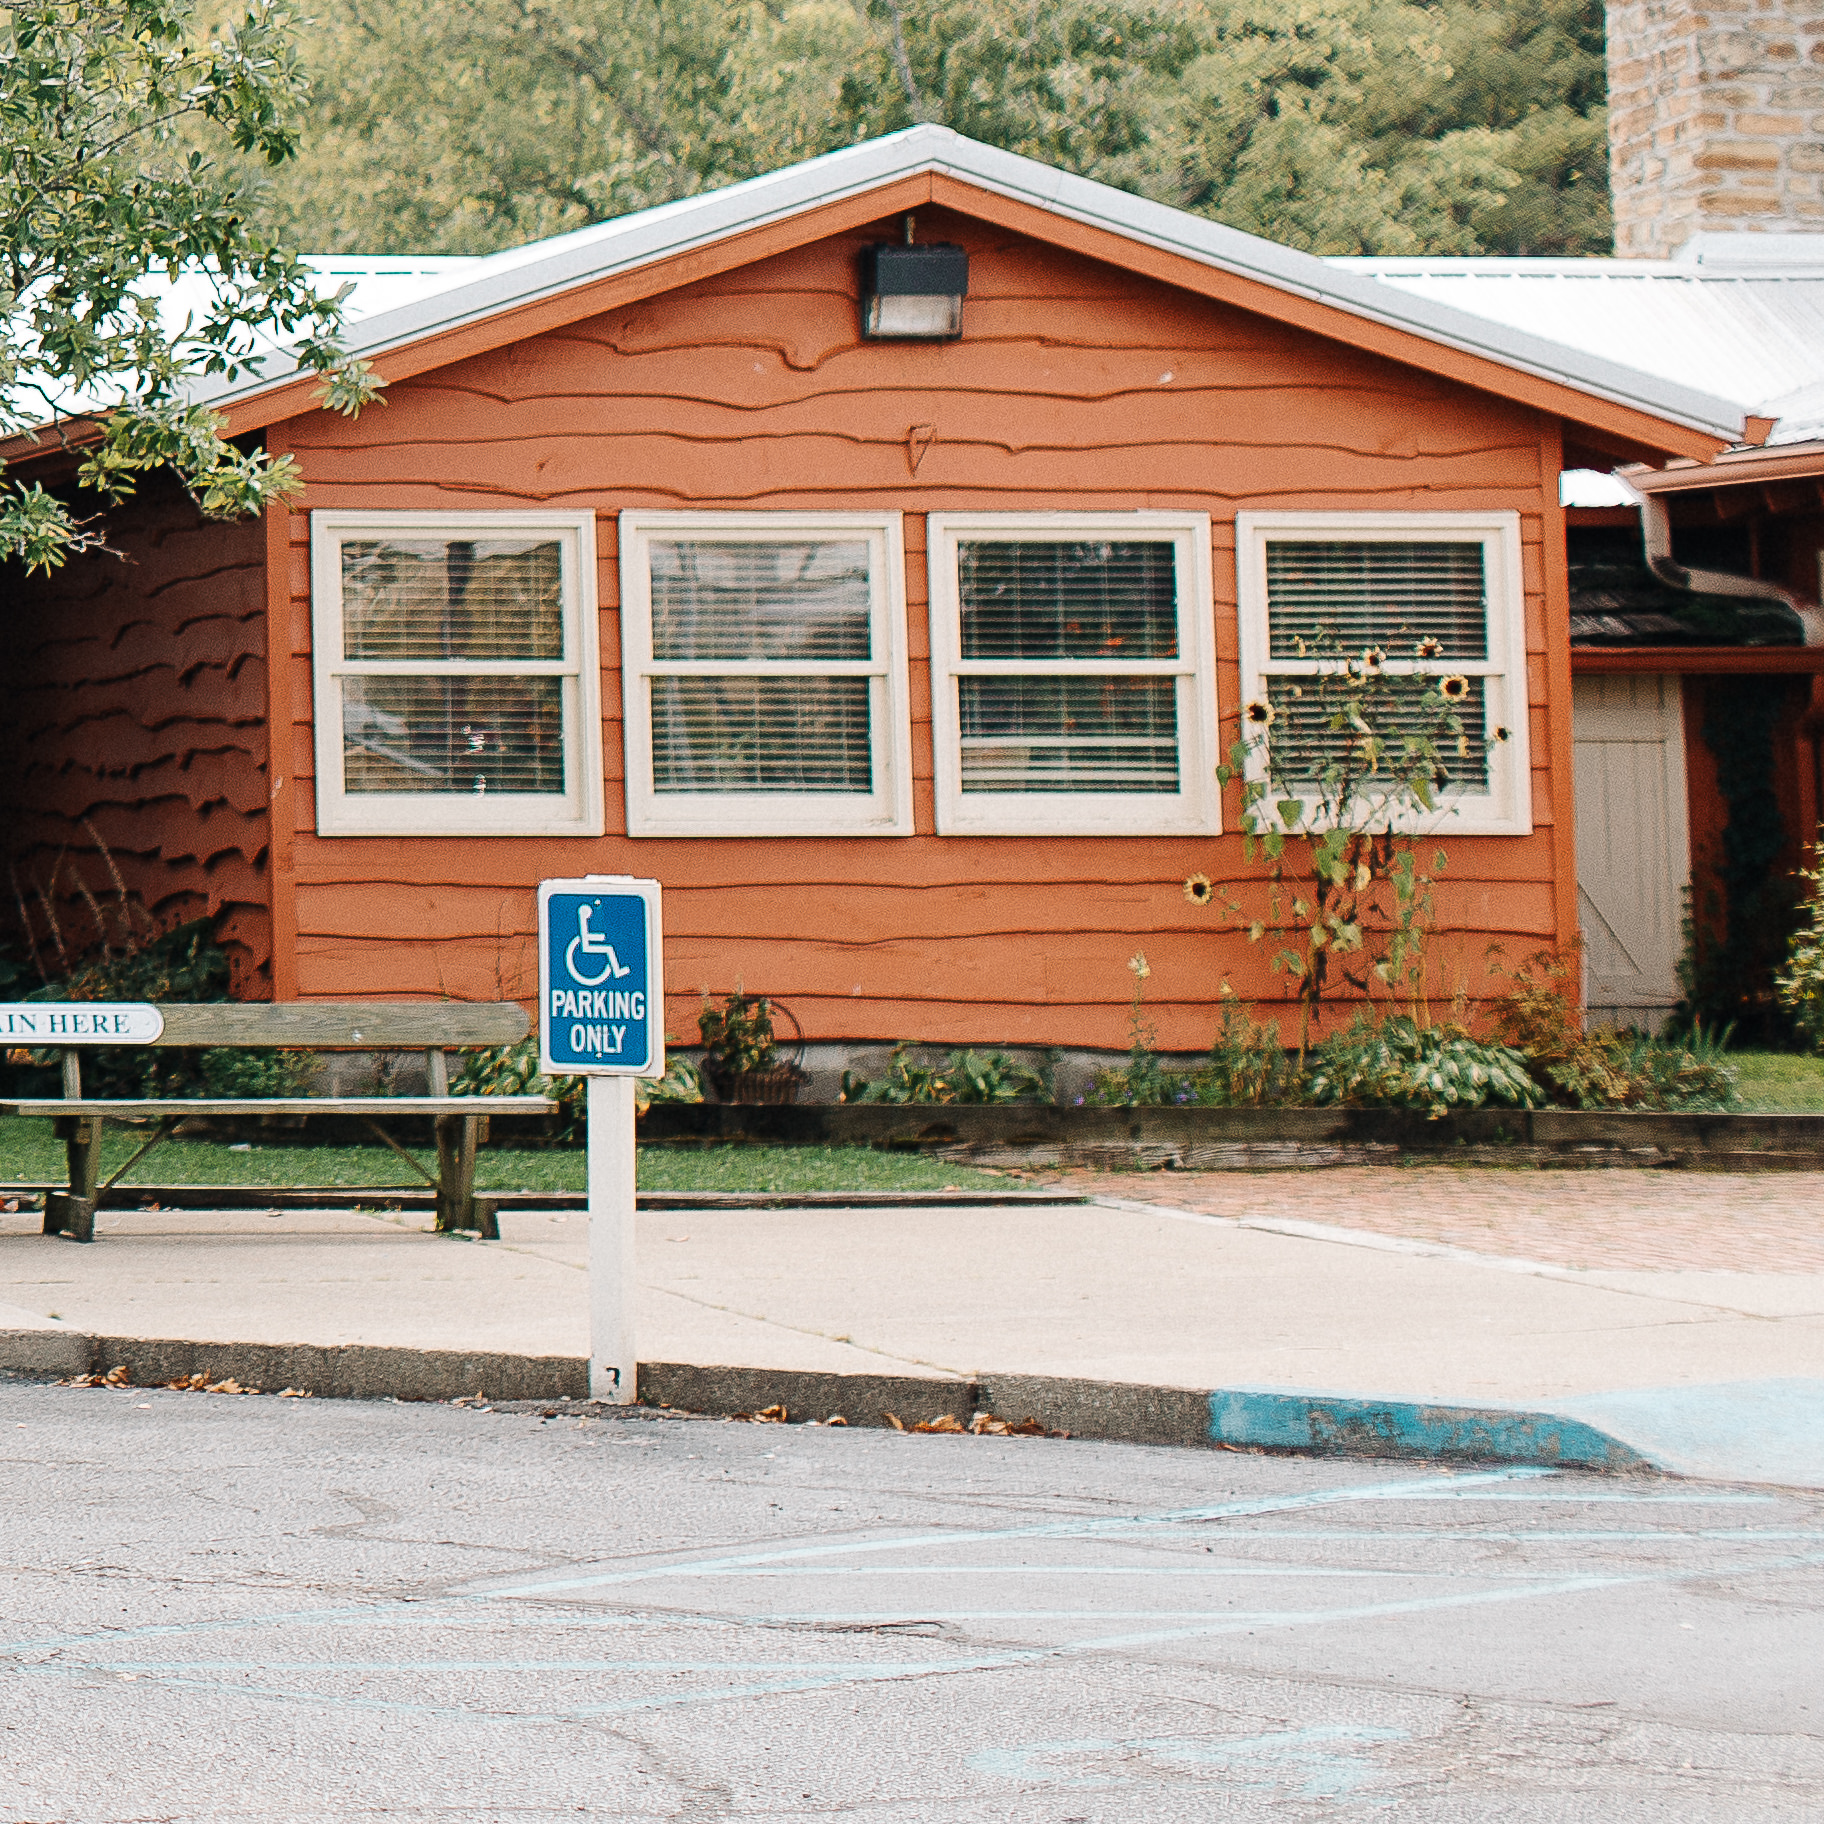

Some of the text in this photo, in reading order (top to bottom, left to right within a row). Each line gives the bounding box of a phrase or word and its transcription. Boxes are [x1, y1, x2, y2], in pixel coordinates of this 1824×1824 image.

[552, 989, 645, 1020] PARKING
[50, 1013, 131, 1034] HERE
[570, 1023, 626, 1054] ONLY
